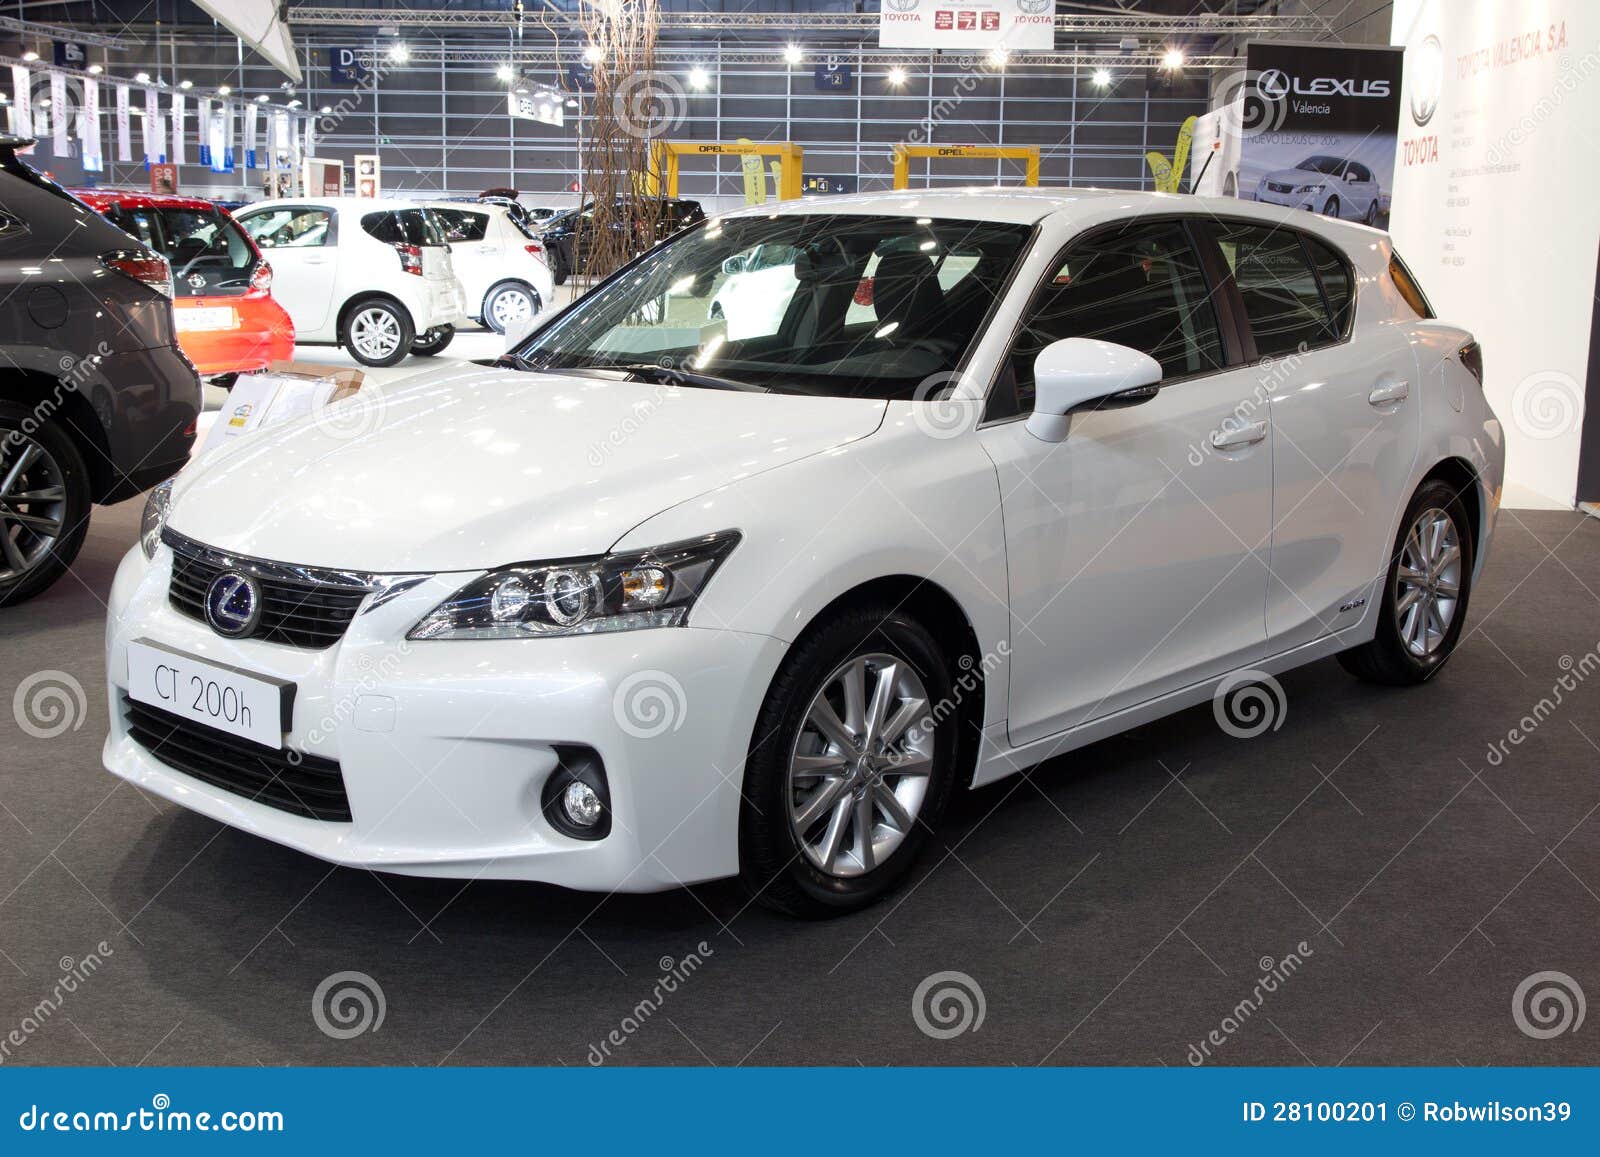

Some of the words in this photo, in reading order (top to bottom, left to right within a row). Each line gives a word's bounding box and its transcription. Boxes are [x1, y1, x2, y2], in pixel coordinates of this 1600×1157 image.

[884, 13, 921, 22] TOYOTA
[1014, 15, 1052, 24] TOYOTA
[340, 49, 354, 66] D
[827, 54, 840, 71] B
[1293, 77, 1390, 98] LEXUS
[1292, 100, 1331, 114] Valencia
[698, 145, 726, 153] OPEL
[938, 148, 965, 156] OPEL
[1403, 135, 1439, 167] TOYOTA
[154, 664, 179, 703] CT
[190, 675, 252, 729] 200h
